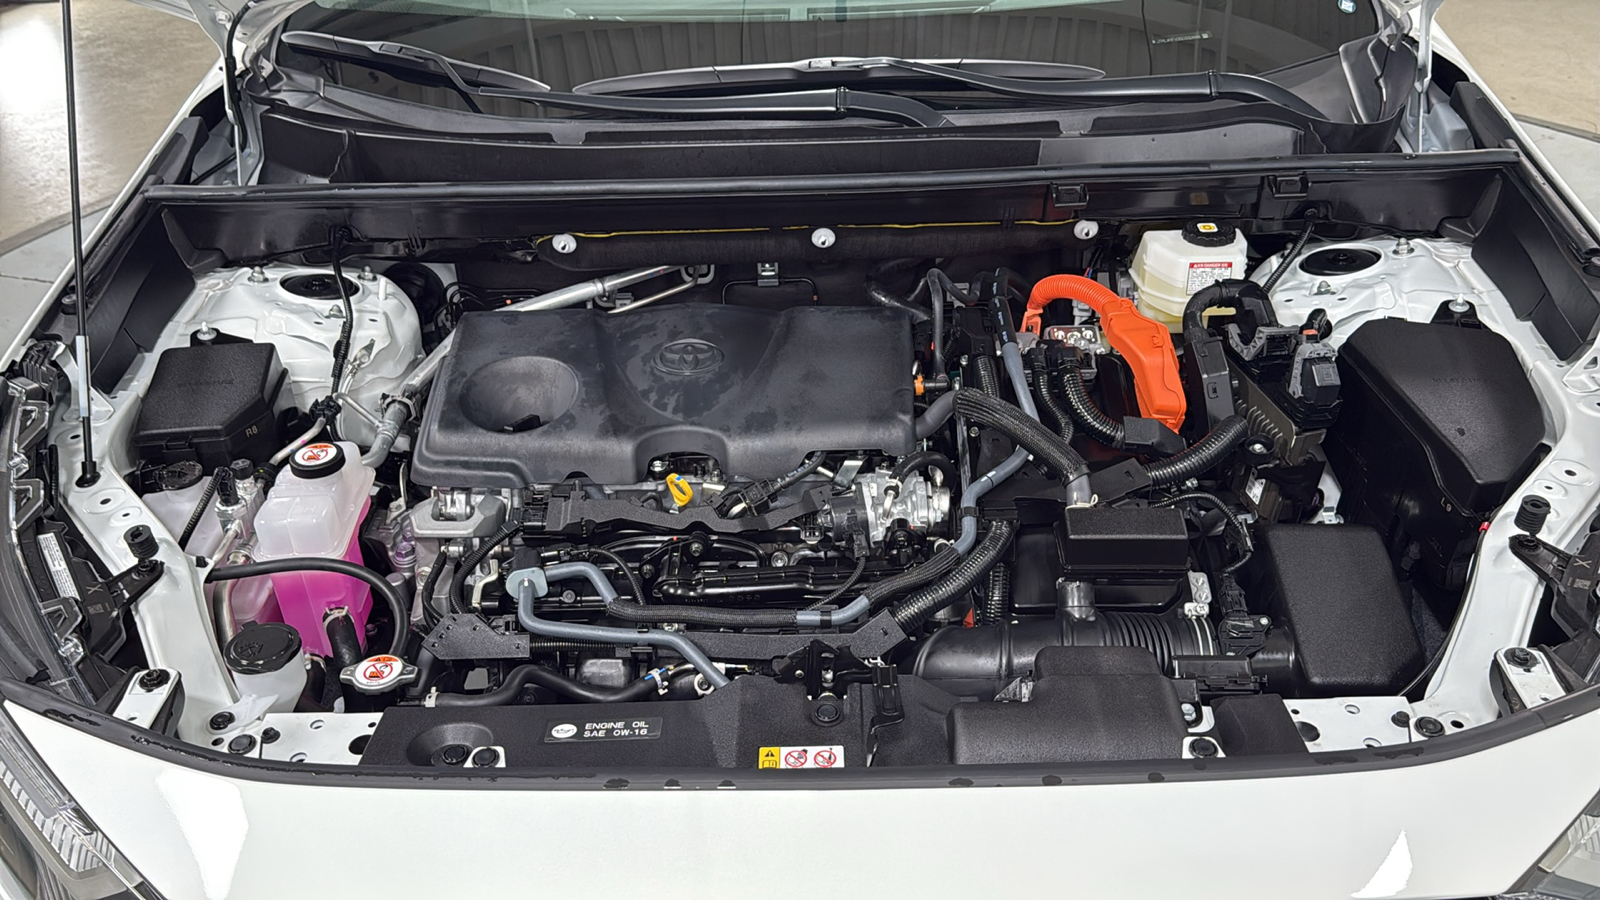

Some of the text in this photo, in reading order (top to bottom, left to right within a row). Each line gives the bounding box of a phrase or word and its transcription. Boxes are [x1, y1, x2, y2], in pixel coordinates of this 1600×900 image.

[245, 425, 259, 438] R8
[1440, 497, 1452, 512] L9
[584, 720, 650, 731] ENGINE OIL
[583, 728, 649, 738] SAE 0W-16
